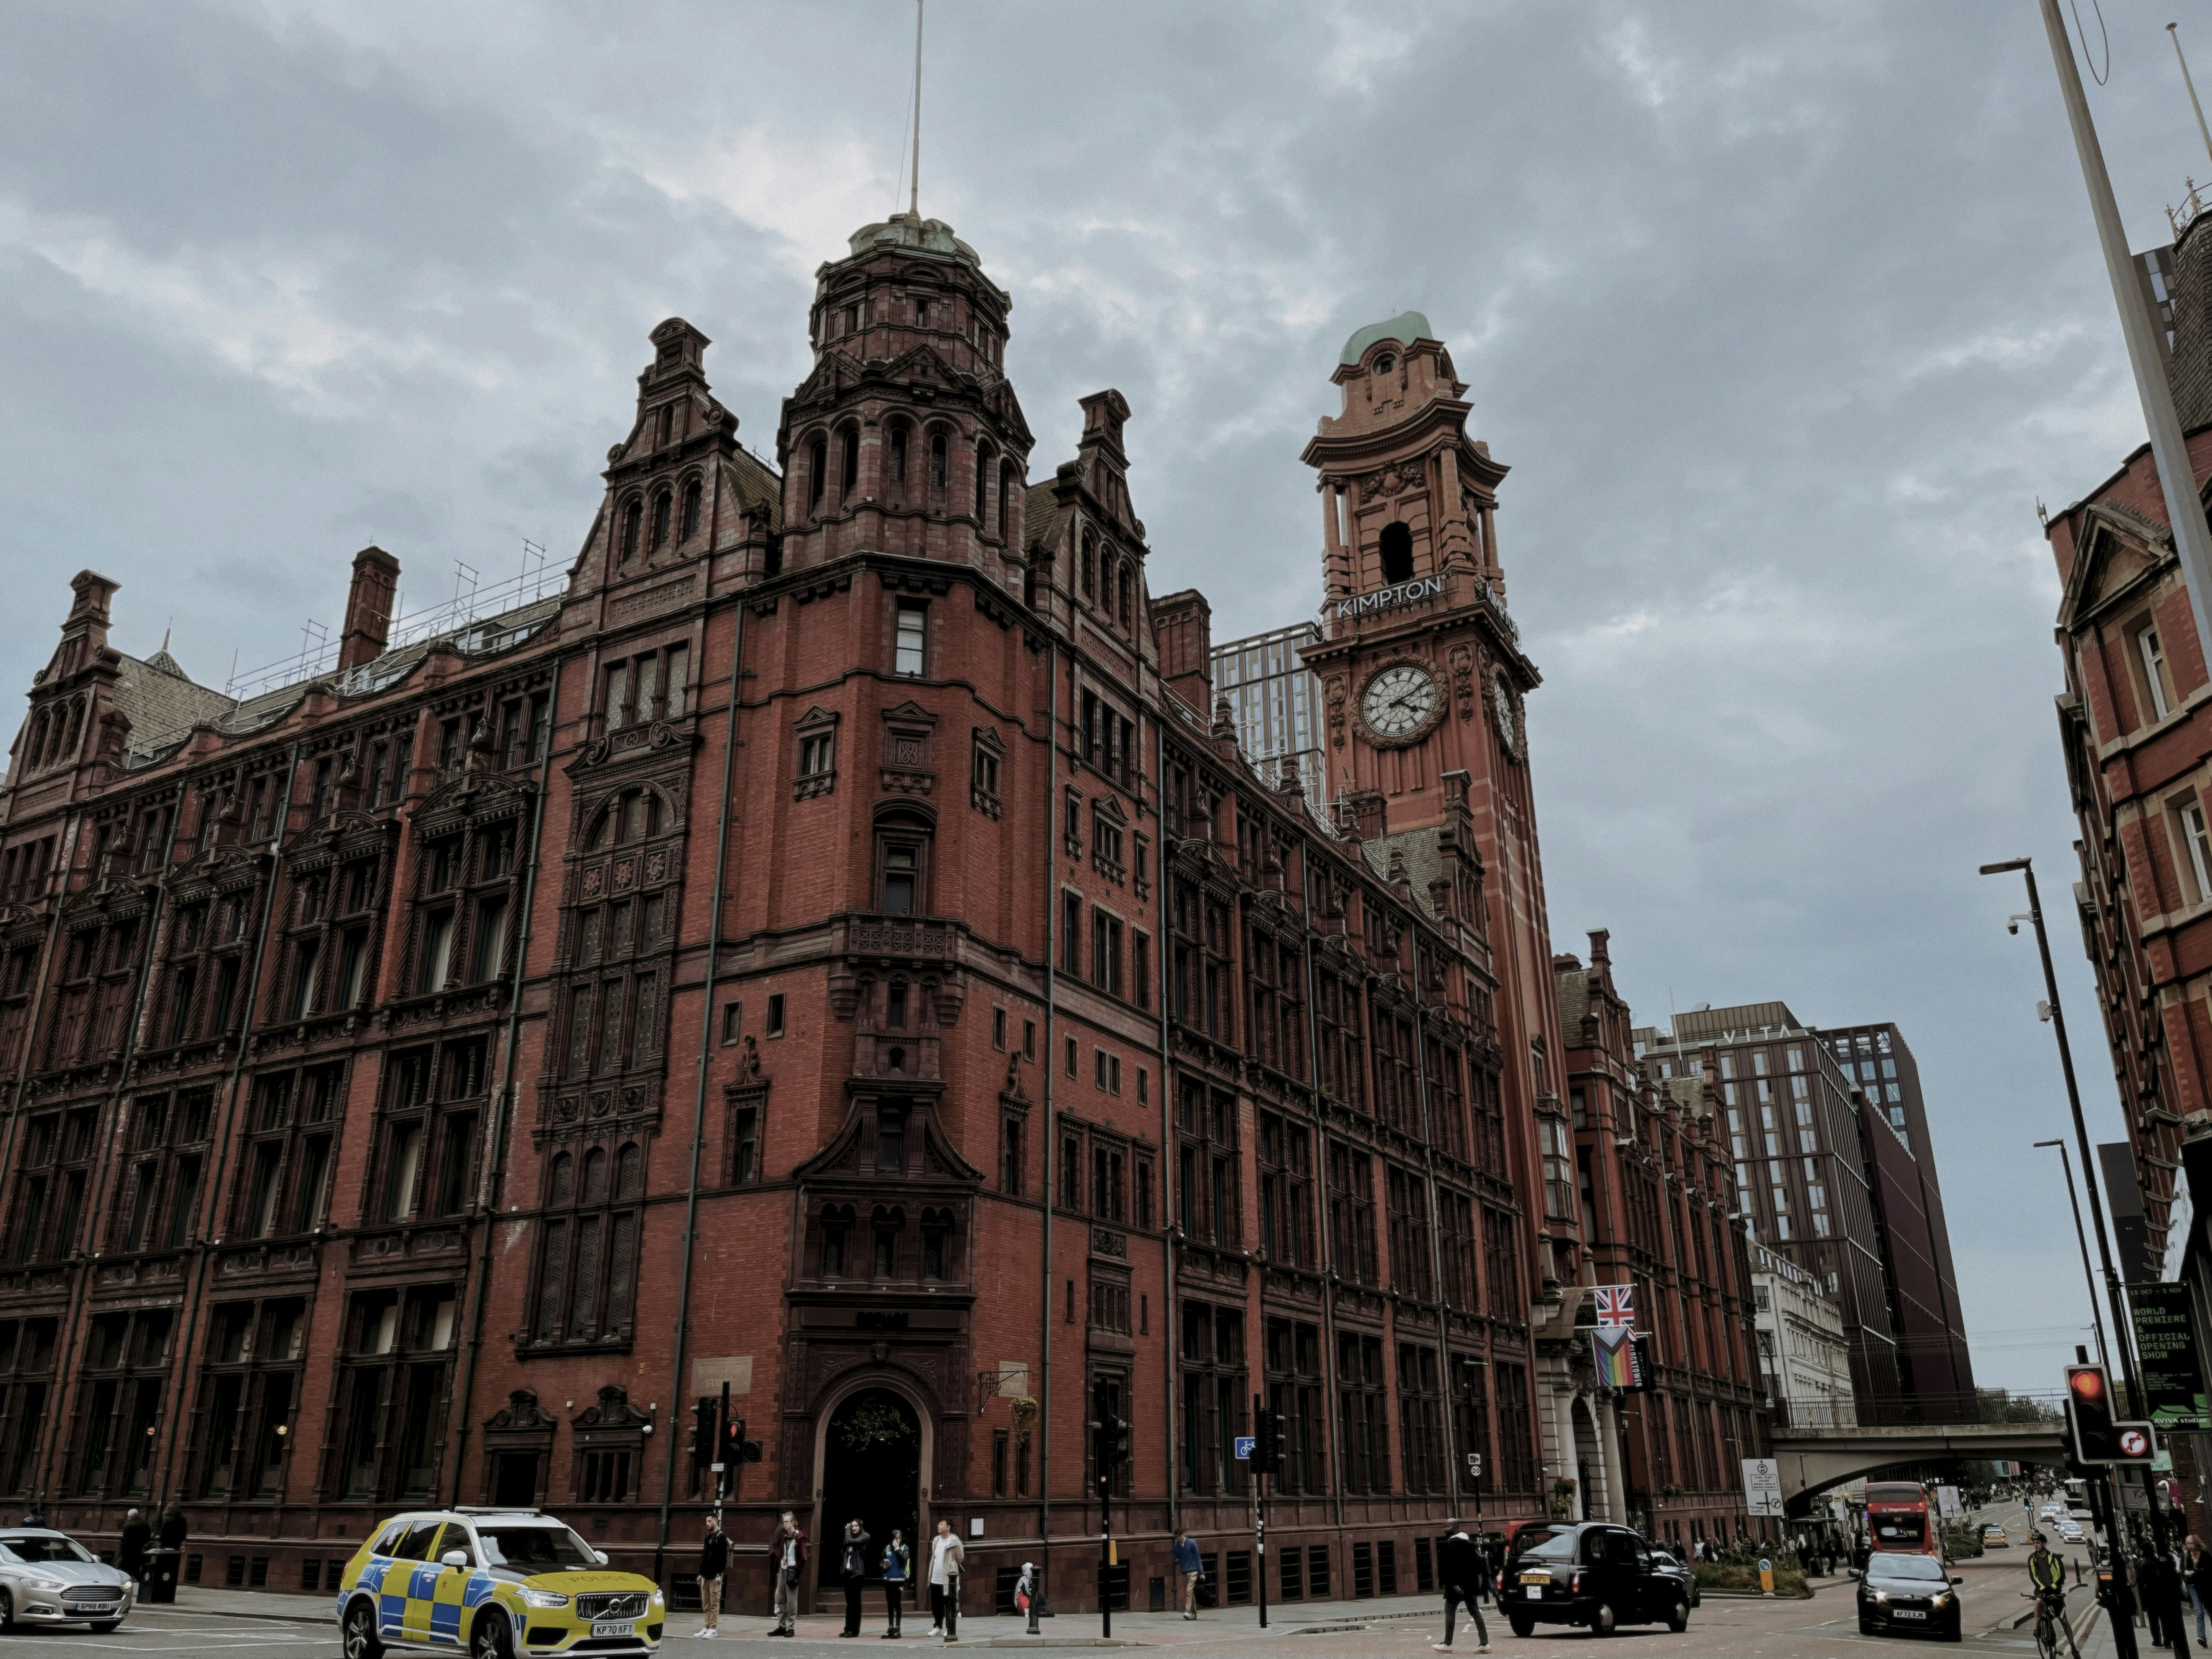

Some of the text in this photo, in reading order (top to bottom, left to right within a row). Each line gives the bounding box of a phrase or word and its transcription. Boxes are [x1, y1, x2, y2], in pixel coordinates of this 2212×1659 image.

[1337, 576, 1440, 618] KIMPTON
[1723, 1024, 1792, 1045] VITA
[2134, 1307, 2166, 1316] WORLD
[2135, 1315, 2187, 1324] PREMIERE
[2139, 1332, 2190, 1342] OFFICIAL
[2140, 1341, 2185, 1351] OPENING
[2142, 1351, 2168, 1360] SHOW
[597, 1624, 633, 1635] KP70 KFT
